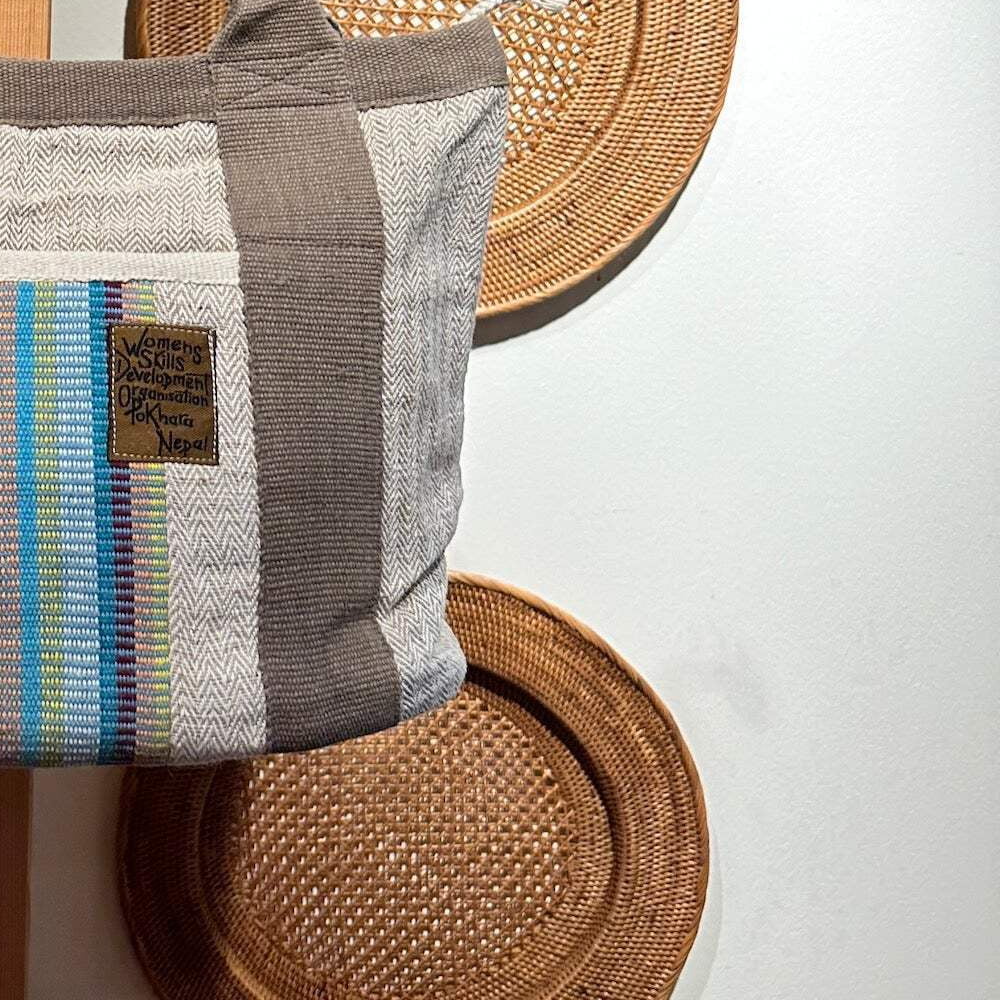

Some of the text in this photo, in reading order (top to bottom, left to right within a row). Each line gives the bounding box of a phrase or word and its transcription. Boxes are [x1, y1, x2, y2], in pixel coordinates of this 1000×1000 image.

[114, 350, 209, 395] Development
[138, 348, 185, 371] Skills
[118, 384, 209, 408] Organisation
[155, 429, 208, 457] Nepal
